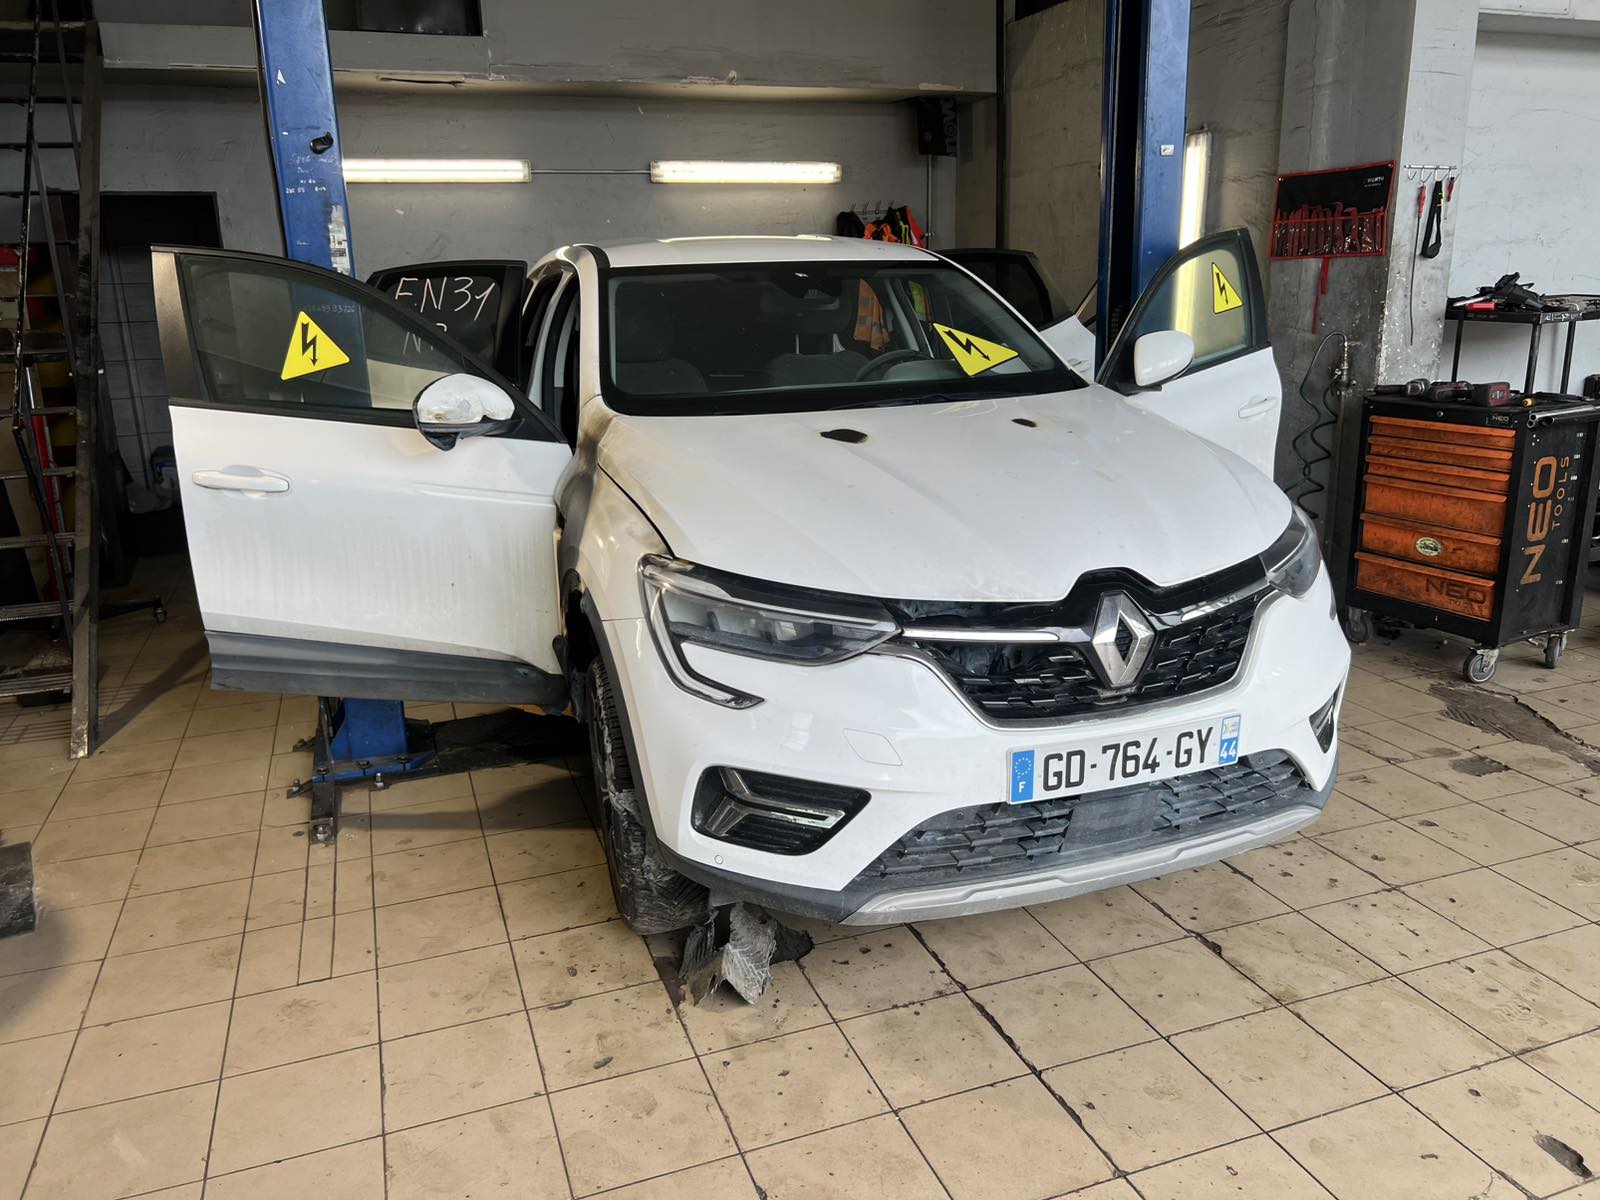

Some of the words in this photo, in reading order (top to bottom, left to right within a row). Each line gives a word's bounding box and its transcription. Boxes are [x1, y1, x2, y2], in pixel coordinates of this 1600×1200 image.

[1551, 455, 1570, 531] TOOLS
[1520, 455, 1558, 585] NEO
[1425, 577, 1487, 604] NEO
[1042, 726, 1214, 792] GD-764-GY
[1220, 740, 1237, 759] 44
[1018, 781, 1026, 793] F
